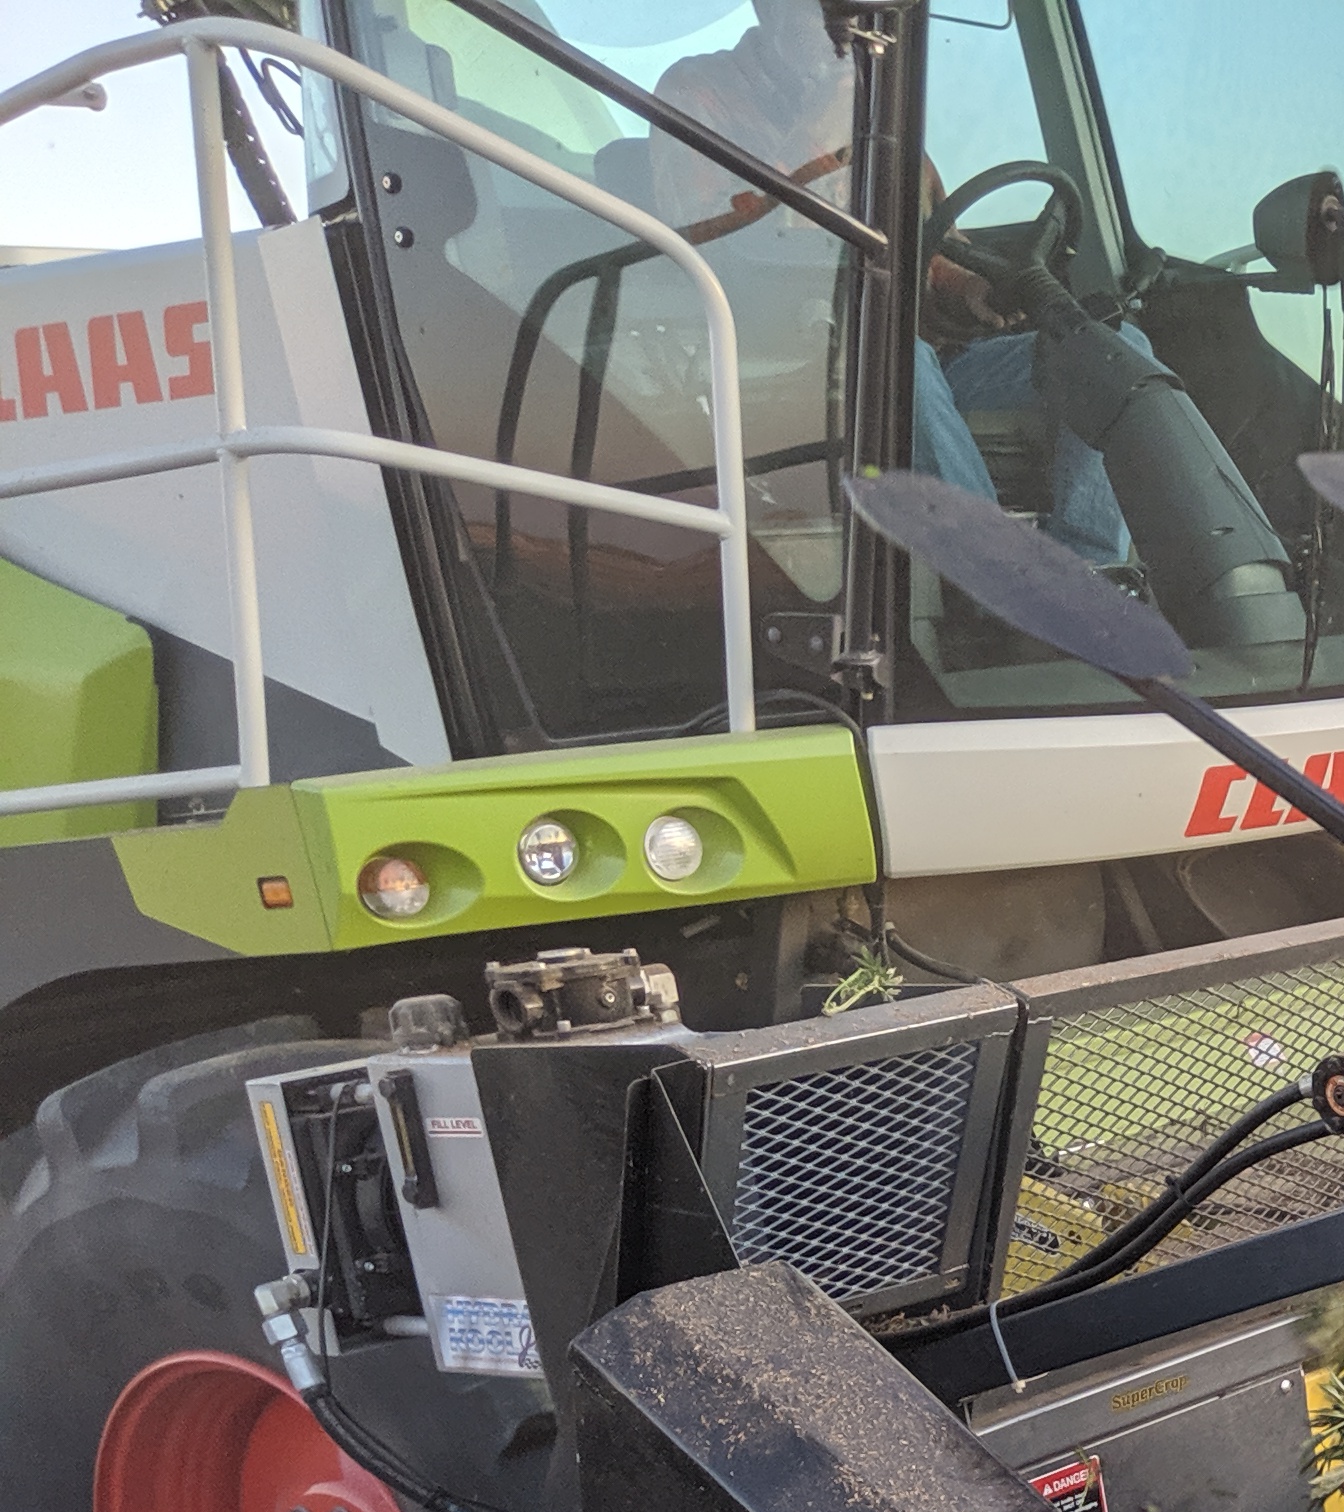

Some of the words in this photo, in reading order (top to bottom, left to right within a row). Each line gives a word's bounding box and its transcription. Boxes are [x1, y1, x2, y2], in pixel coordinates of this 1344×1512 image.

[450, 1119, 477, 1129] LEVEL
[1111, 1375, 1188, 1411] SuperCrop
[1052, 1467, 1096, 1493] DANGE
